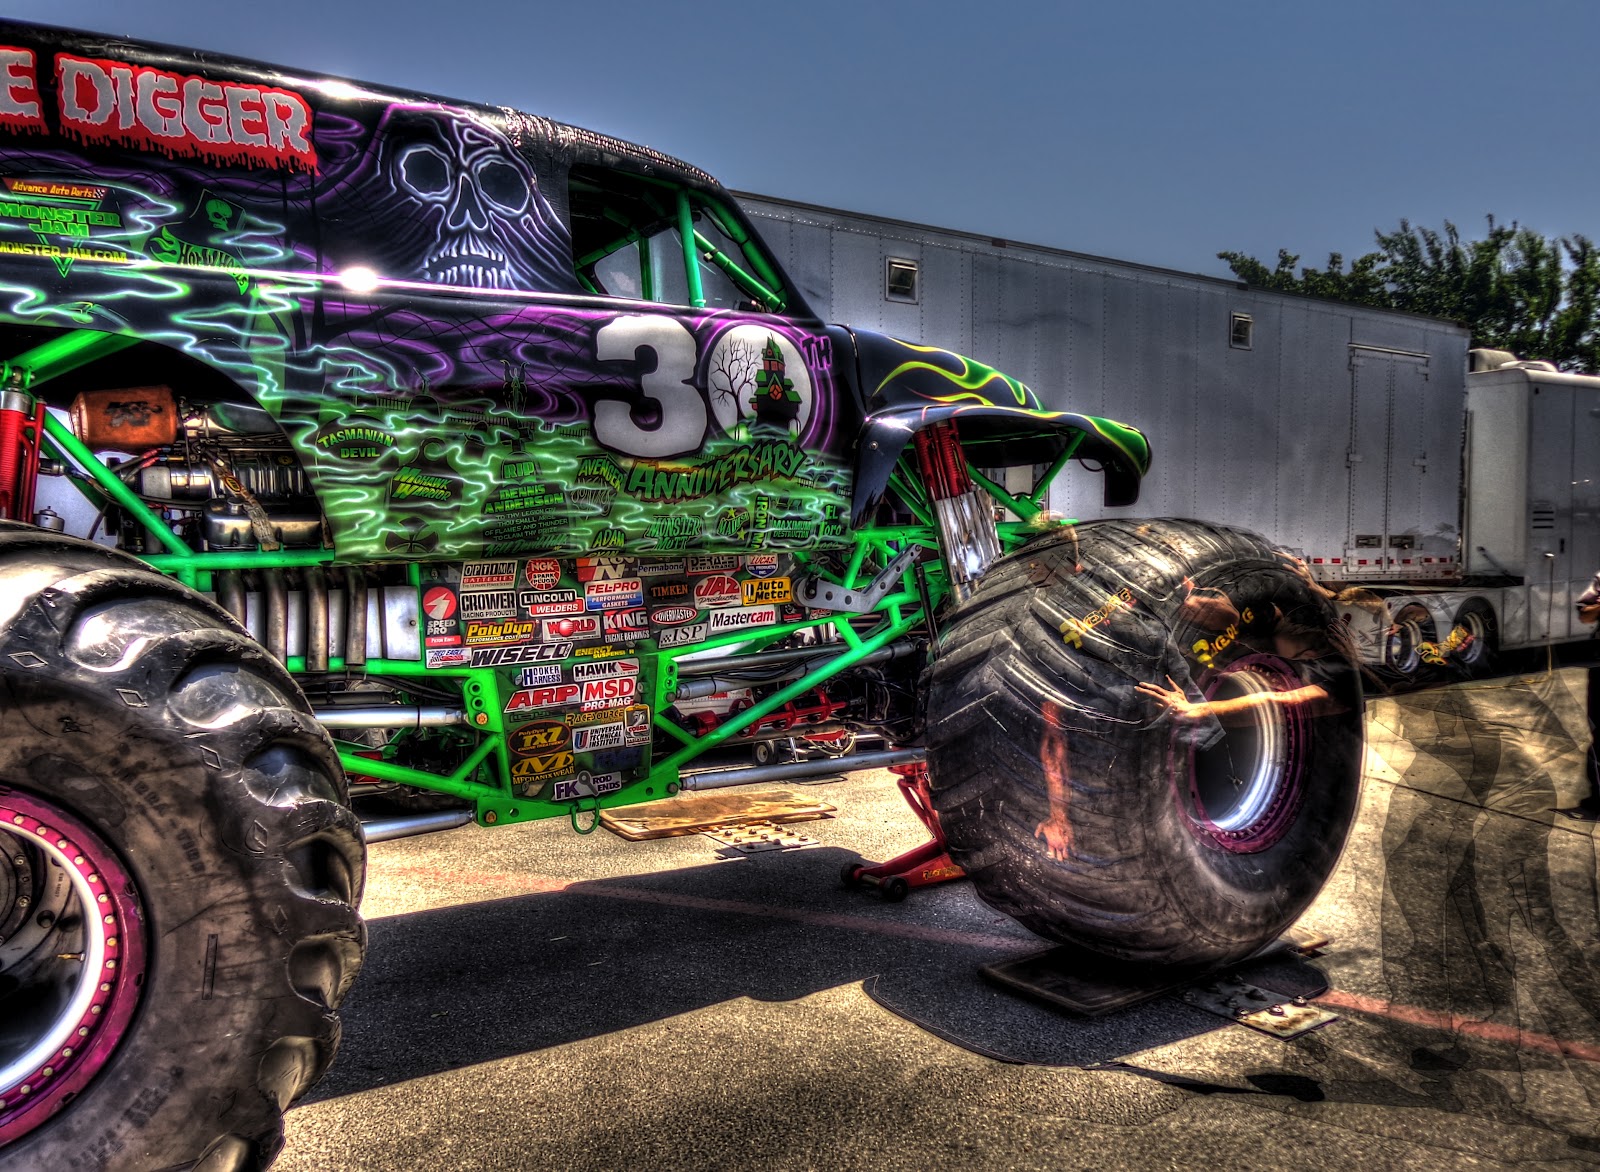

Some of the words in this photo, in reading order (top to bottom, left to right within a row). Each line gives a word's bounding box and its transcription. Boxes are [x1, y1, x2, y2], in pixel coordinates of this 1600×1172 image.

[58, 57, 311, 153] DIGGER
[13, 181, 47, 193] Advance
[50, 185, 70, 195] Auto
[71, 187, 92, 198] Parts
[0, 203, 121, 227] MONSTER
[28, 220, 89, 237] JAM
[801, 335, 832, 370] TH
[317, 428, 394, 448] TASMANIAN
[341, 448, 380, 459] DEVIL
[503, 462, 535, 478] RIP
[578, 459, 622, 491] AVENGER
[627, 443, 803, 499] ANNIVERSARY
[393, 466, 452, 489] MOHAWK
[391, 483, 452, 500] WARRIOR
[500, 484, 545, 500] DENNIS
[484, 493, 565, 514] ANDERSON
[755, 496, 769, 528] IRON
[825, 505, 839, 520] EL
[538, 518, 568, 528] THUNDER
[647, 517, 702, 538] MONSTER
[772, 520, 811, 531] MAXIMUM
[592, 530, 625, 548] ADAM
[772, 530, 810, 538] DESTRUCTION
[532, 561, 555, 572] NGK
[638, 562, 684, 572] Permabond
[750, 556, 775, 565] LUCAS
[465, 563, 515, 577] OPTIMA
[463, 575, 514, 584] BATTERIES
[695, 576, 740, 597] JAZ
[757, 581, 783, 591] Auto
[587, 582, 639, 595] FEL-PRO
[651, 584, 688, 597] TIMKEN
[755, 590, 789, 600] Meter
[461, 593, 515, 612] CROWER
[524, 592, 573, 604] LINCOLN
[591, 594, 636, 603] PERFORMANCE
[602, 600, 628, 608] GASKETS
[485, 609, 516, 617] PRODUCTS
[536, 603, 578, 613] WELDERS
[602, 611, 648, 630] KING
[655, 609, 694, 622] POWERMASTER
[712, 610, 774, 627] Mastercam
[427, 620, 456, 628] SPEED
[427, 627, 448, 636] PRO
[604, 634, 624, 644] ENGINE
[624, 630, 650, 640] BEARINGS
[673, 625, 702, 641] ISP
[471, 643, 566, 667] WISECO
[575, 645, 613, 656] ENERGY
[575, 662, 617, 677] HAWK
[585, 678, 634, 701] MSD
[507, 685, 579, 709] ARP
[590, 725, 623, 735] UNIVERSAL
[590, 731, 621, 741] TECHNICAL
[589, 736, 620, 748] INSTITUTE
[512, 773, 553, 785] MECHANIX
[553, 765, 576, 778] WEAR
[593, 775, 612, 784] ROD
[555, 780, 580, 799] FK
[597, 781, 620, 791] ENDS
